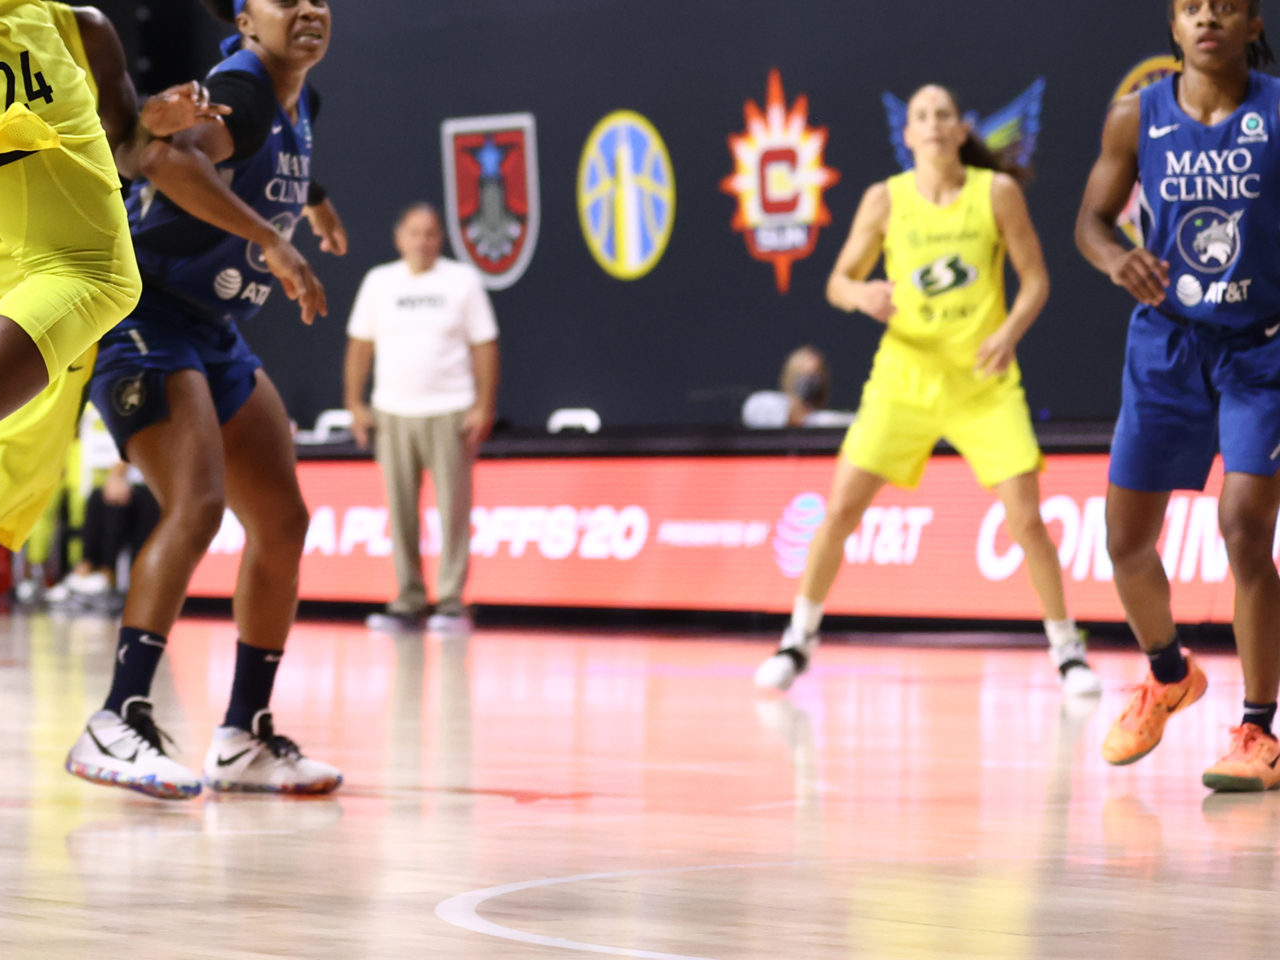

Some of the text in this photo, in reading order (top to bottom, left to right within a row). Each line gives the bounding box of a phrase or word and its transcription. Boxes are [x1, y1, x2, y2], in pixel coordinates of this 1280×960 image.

[1165, 147, 1252, 175] MAYO
[760, 148, 800, 214] C
[1159, 173, 1261, 202] CLINIC
[1203, 278, 1252, 304] AT&T
